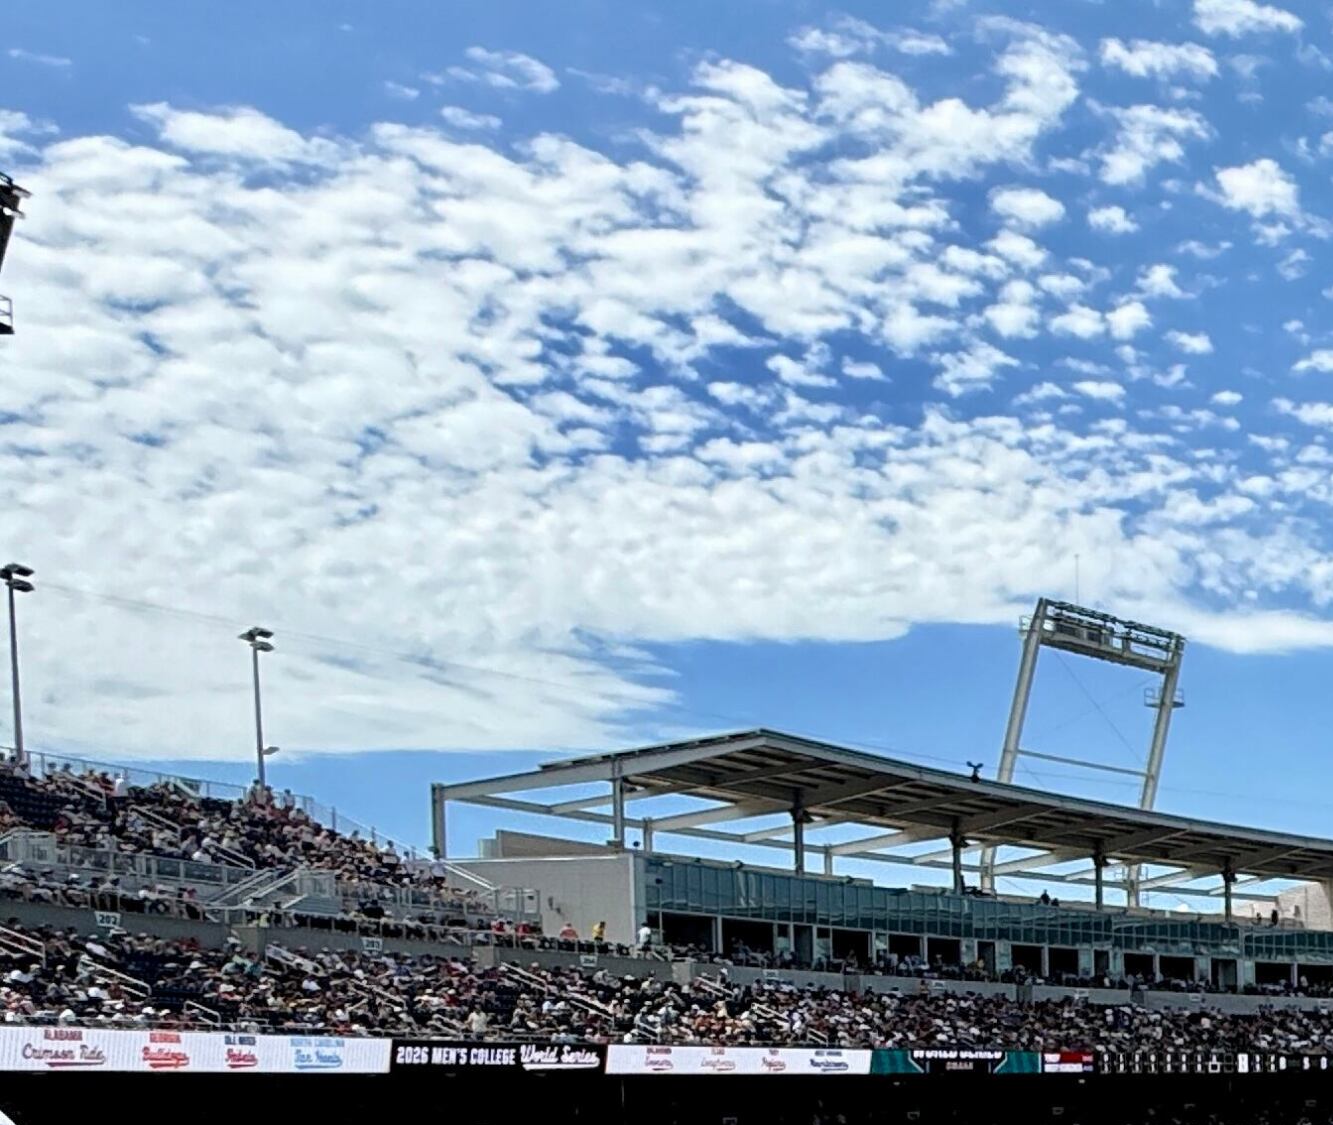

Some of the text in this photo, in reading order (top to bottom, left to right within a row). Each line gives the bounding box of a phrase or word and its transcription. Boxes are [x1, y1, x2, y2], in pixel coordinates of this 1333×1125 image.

[22, 1043, 106, 1062] Crimson Tide
[142, 1046, 189, 1067] Bulldogs
[396, 1044, 600, 1065] 2026 MEN'S COLLEGE World Series
